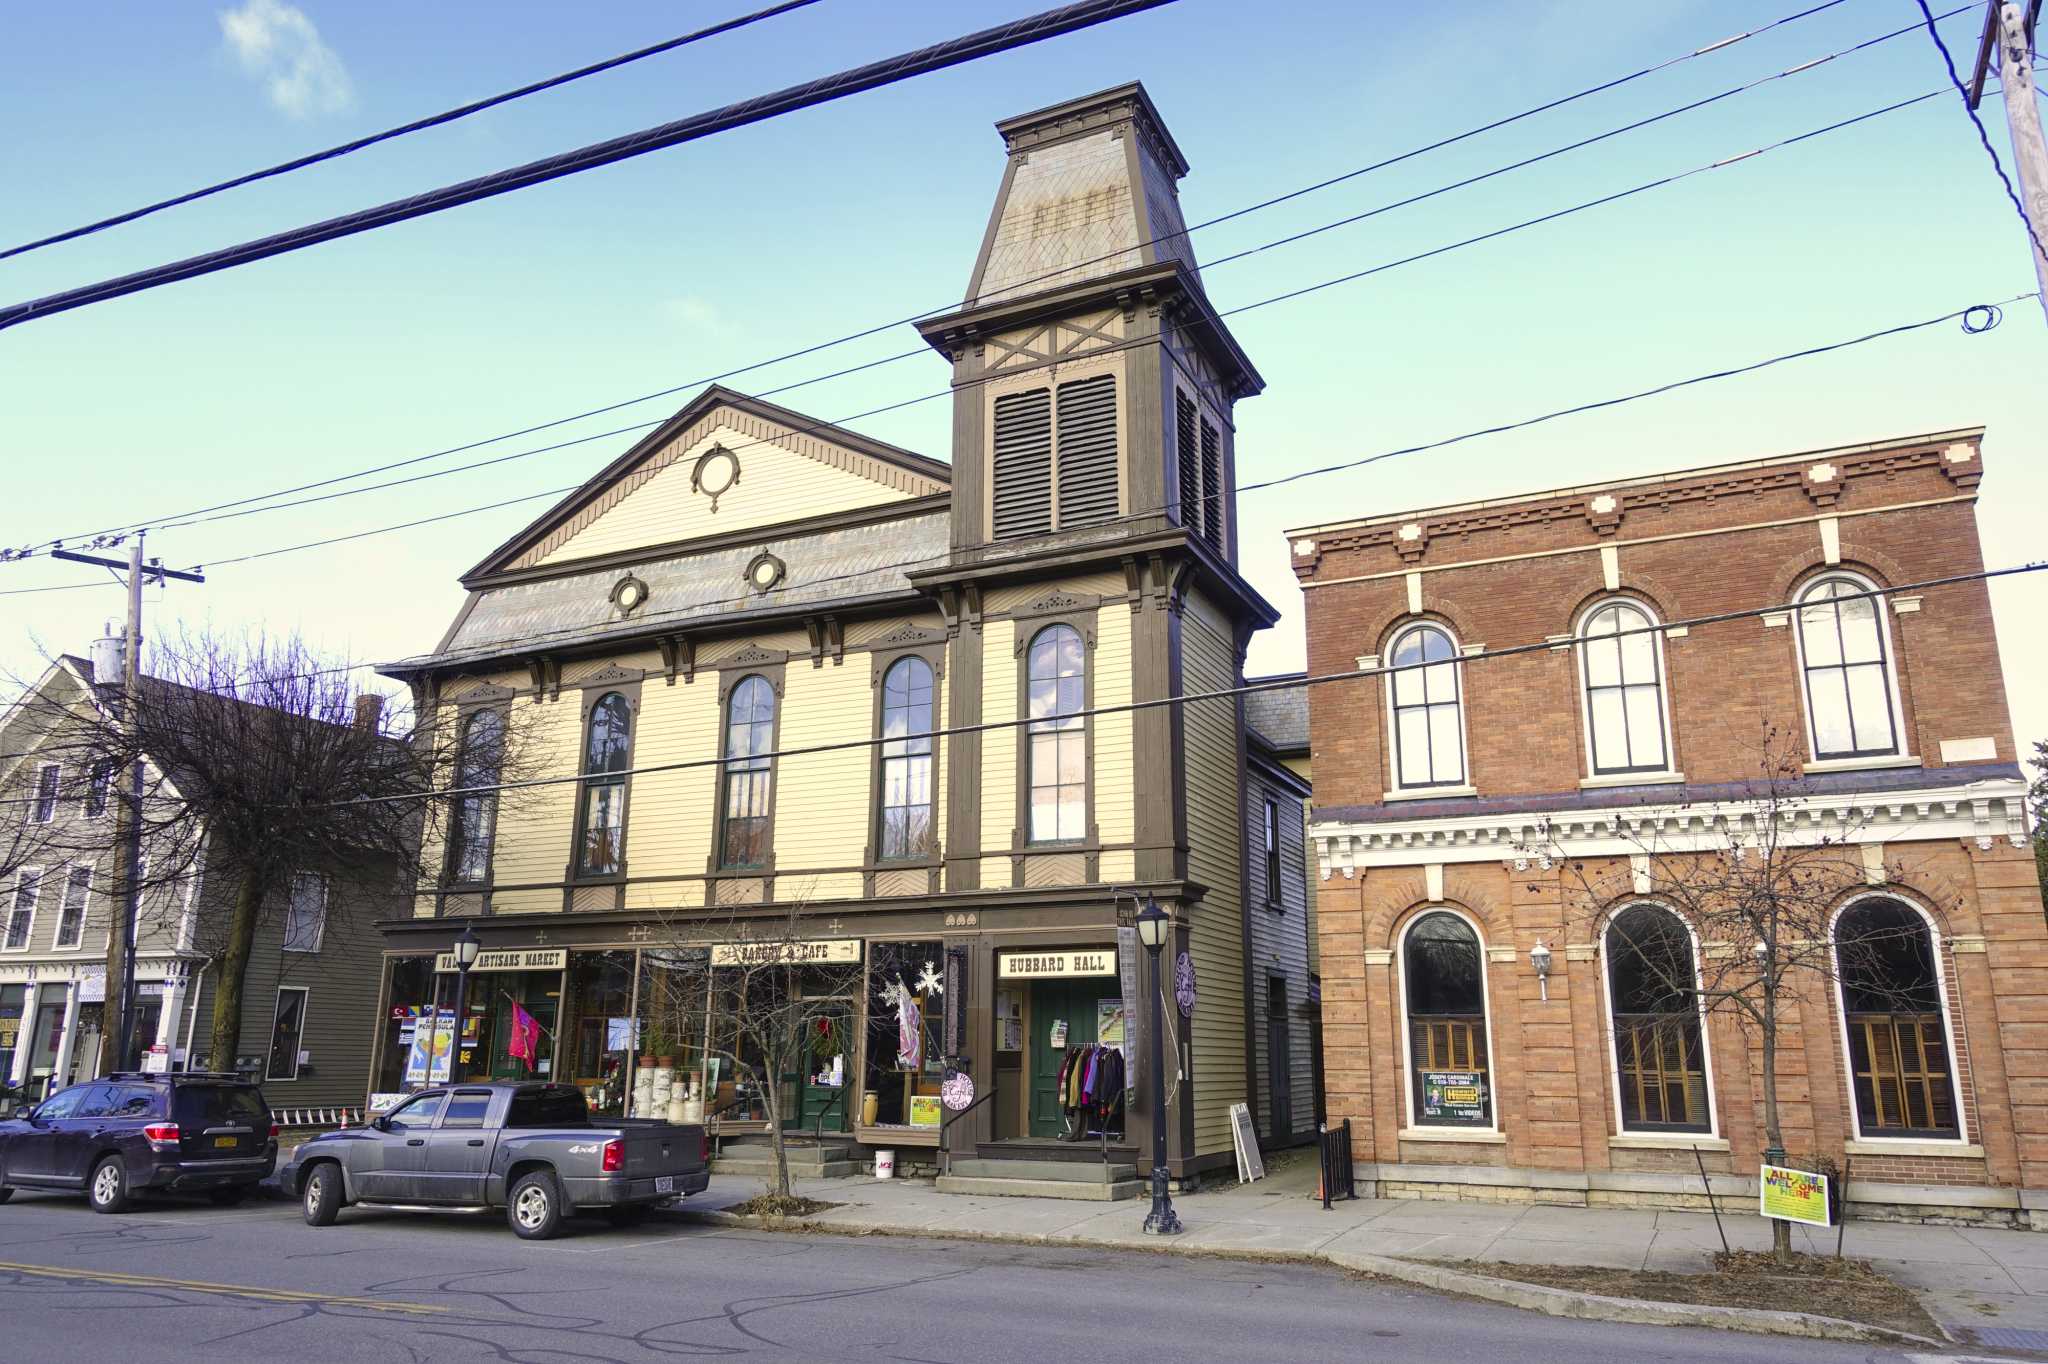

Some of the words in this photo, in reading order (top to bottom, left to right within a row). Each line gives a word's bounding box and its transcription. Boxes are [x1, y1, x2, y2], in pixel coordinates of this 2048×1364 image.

[801, 944, 828, 959] CAFE
[478, 953, 520, 967] ARTISANS
[524, 952, 561, 966] MARKET
[1009, 957, 1064, 973] HUBBARD
[1074, 955, 1105, 971] HALL
[568, 1145, 598, 1154] 4x4
[1771, 1169, 1792, 1181] ALL
[1780, 1187, 1810, 1200] HERE
